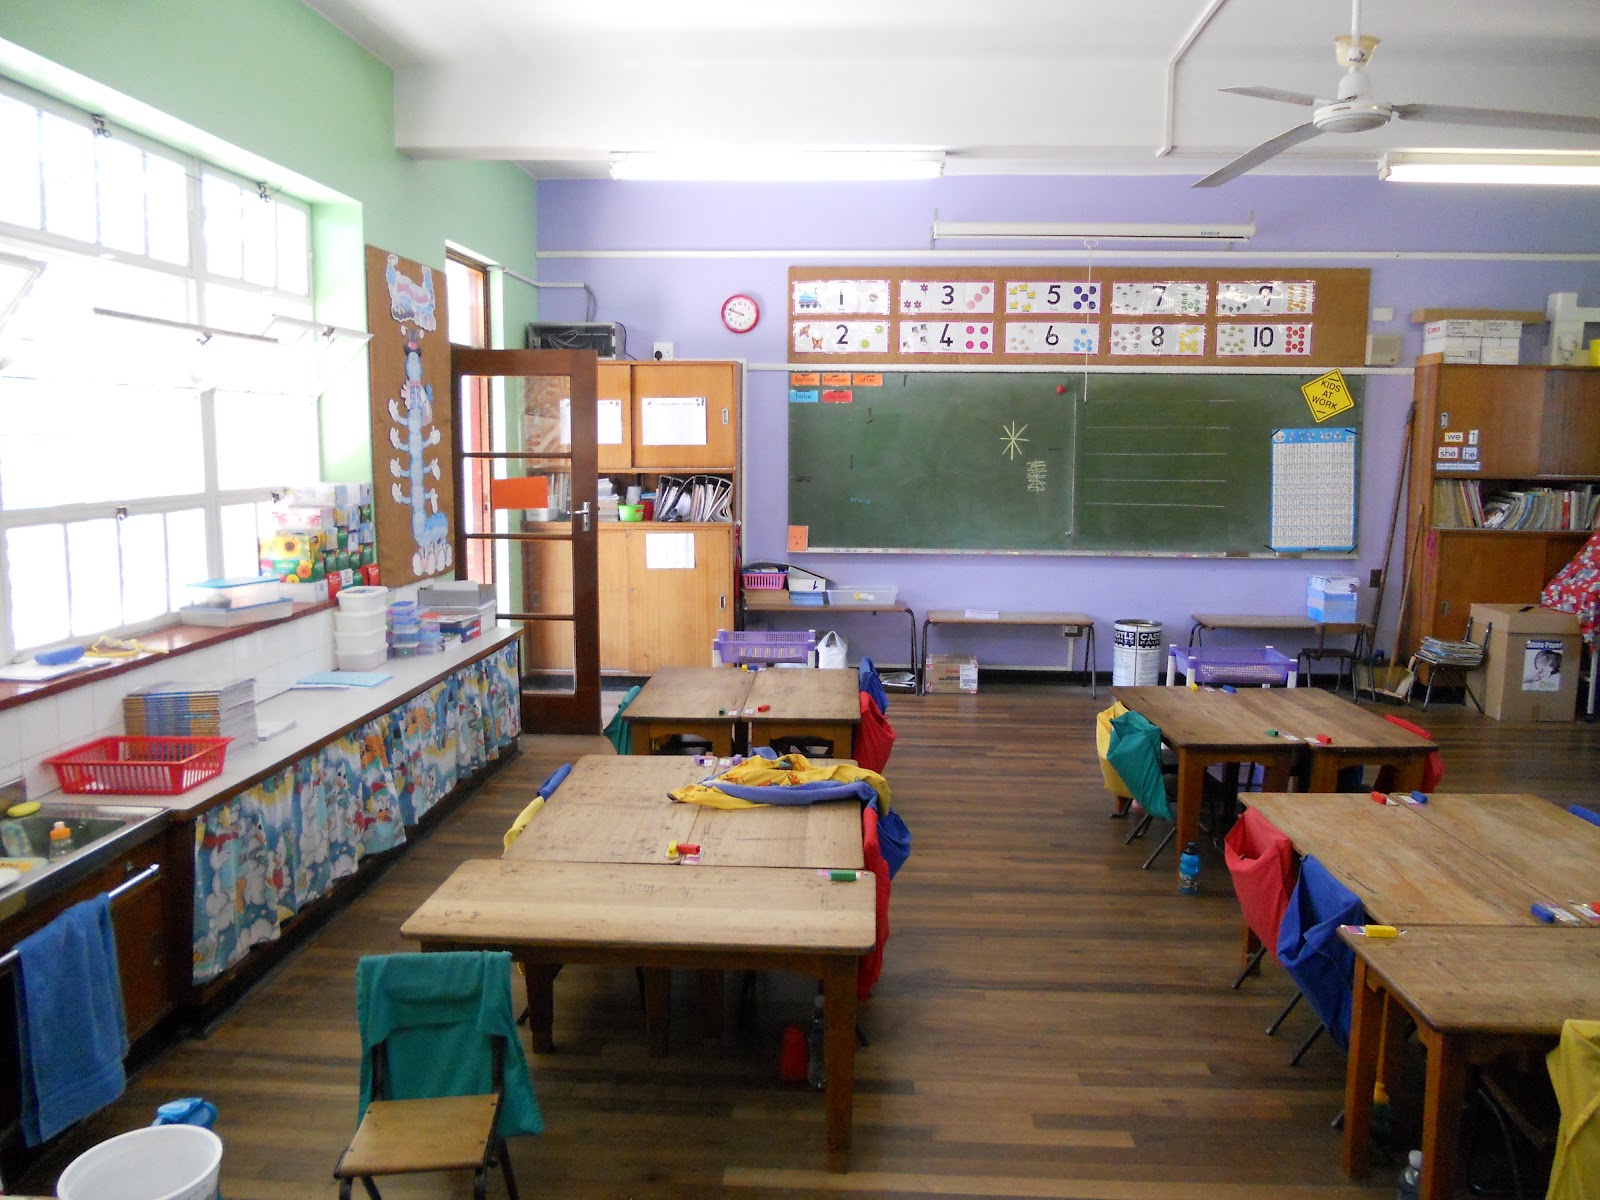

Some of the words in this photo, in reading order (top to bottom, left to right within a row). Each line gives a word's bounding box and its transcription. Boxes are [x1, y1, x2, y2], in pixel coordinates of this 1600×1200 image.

[940, 285, 954, 305] 3
[1047, 285, 1061, 305] 5
[1152, 285, 1166, 306] 7
[1258, 285, 1273, 306] 9
[836, 324, 848, 345] 2
[940, 323, 953, 347] 4
[1045, 325, 1059, 346] 6
[1151, 326, 1164, 347] 8
[1253, 326, 1274, 348] 10
[1320, 380, 1341, 393] KIDS
[1321, 390, 1334, 399] AT
[1312, 395, 1338, 411] WORK
[1440, 449, 1456, 458] she
[1464, 449, 1476, 458] he
